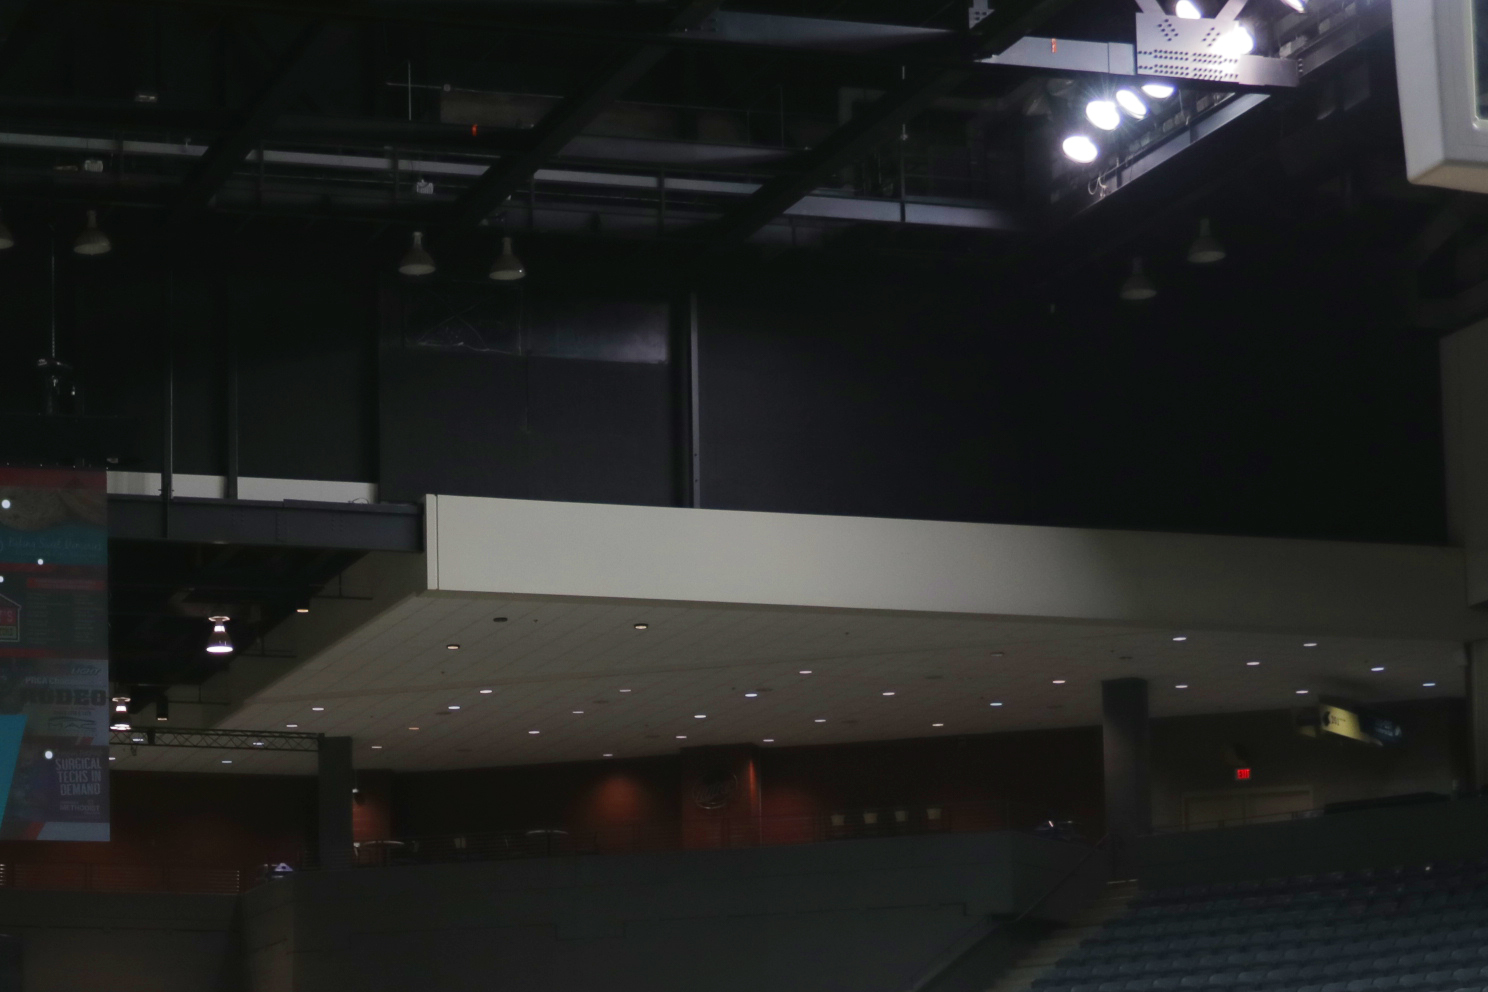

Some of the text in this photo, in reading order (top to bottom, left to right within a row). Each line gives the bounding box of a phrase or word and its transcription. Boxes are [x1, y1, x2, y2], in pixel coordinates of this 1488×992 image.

[55, 757, 102, 770] SURGICAL
[57, 769, 102, 783] TECHS IN
[60, 782, 101, 796] DEMAND
